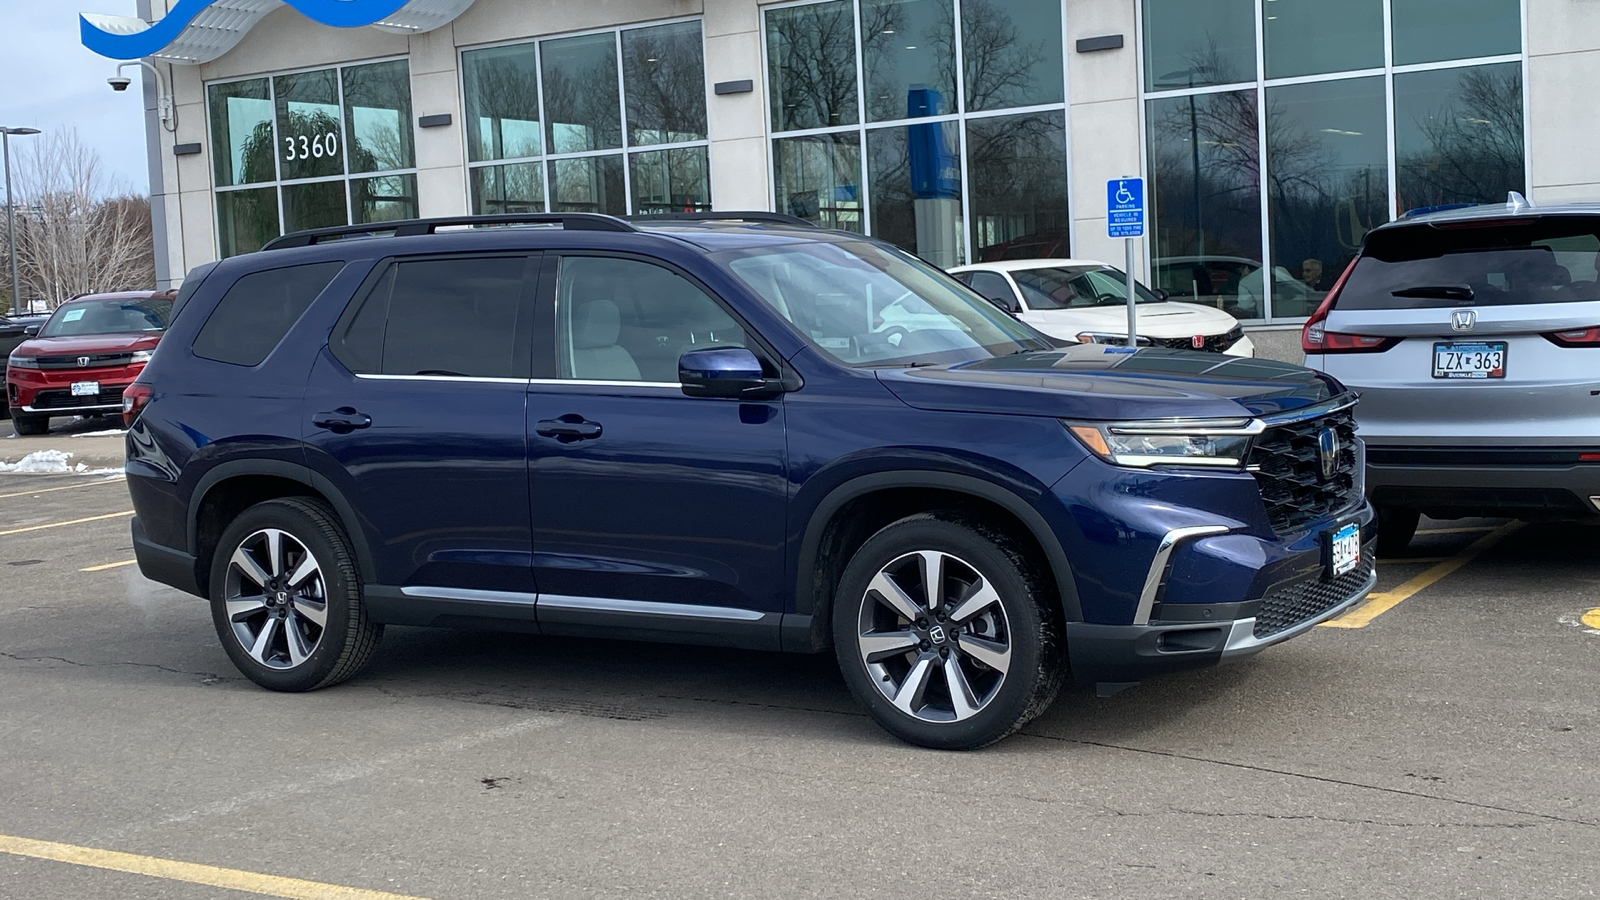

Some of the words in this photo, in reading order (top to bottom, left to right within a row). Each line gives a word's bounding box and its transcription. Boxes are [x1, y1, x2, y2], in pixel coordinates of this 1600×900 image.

[285, 132, 337, 160] 3360
[1437, 352, 1463, 370] LZX
[1474, 352, 1501, 370] 363
